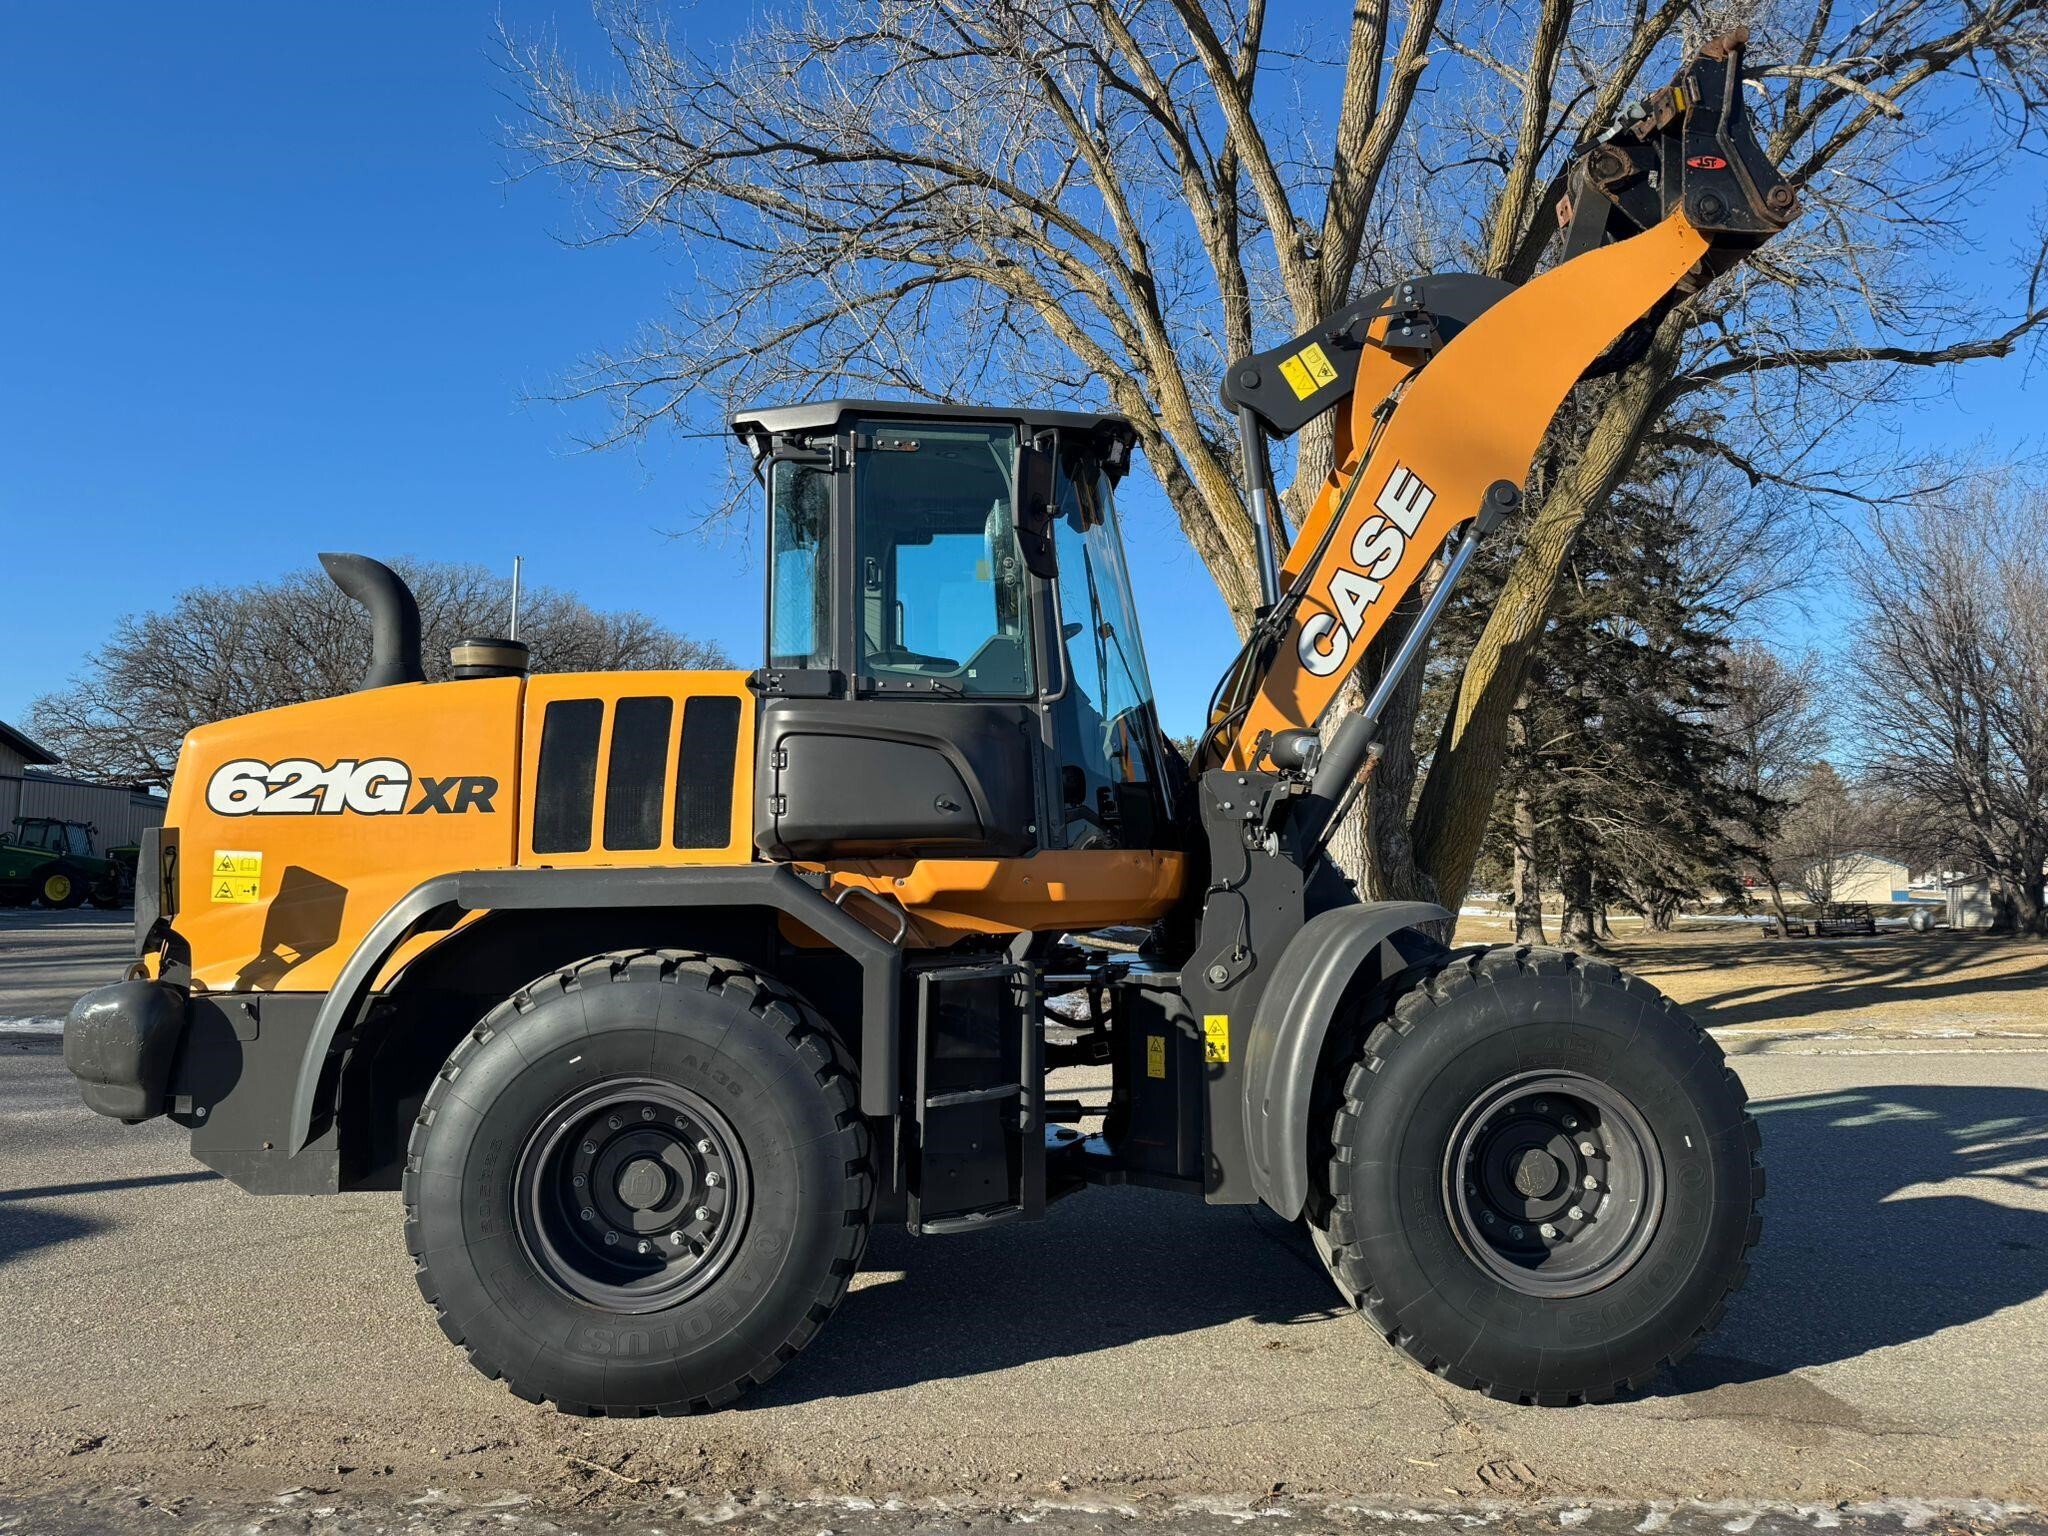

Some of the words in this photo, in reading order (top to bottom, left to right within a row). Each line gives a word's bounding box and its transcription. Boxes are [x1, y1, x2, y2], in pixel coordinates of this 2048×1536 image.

[1297, 459, 1436, 677] CASE
[205, 757, 413, 817] 621G
[407, 776, 499, 815] XR
[577, 1260, 765, 1357] AEOLUS
